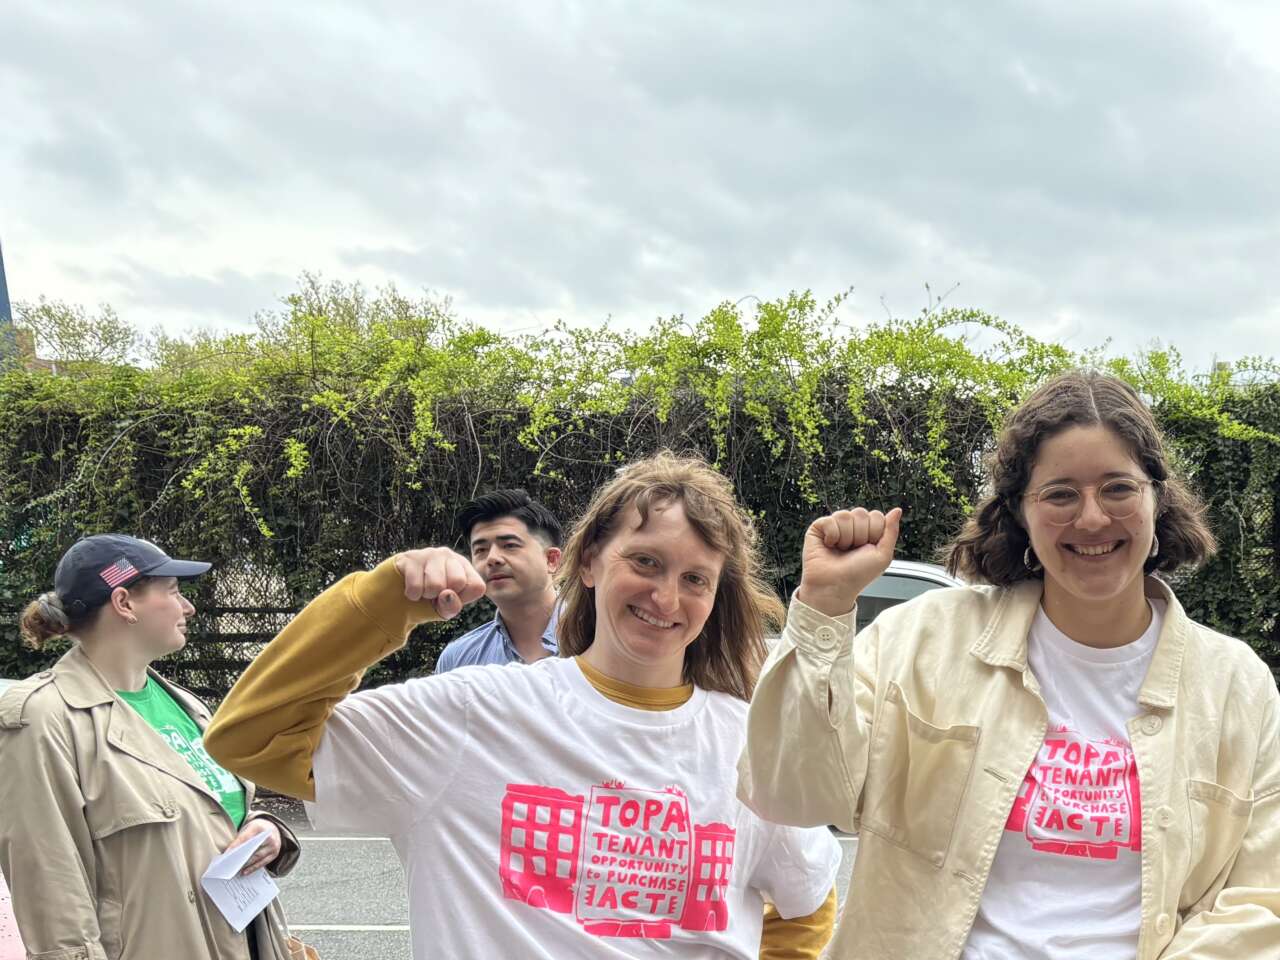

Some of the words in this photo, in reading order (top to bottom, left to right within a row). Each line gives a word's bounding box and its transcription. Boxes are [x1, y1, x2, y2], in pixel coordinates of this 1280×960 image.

[1045, 740, 1120, 768] TOPA
[1040, 766, 1123, 786] TENANT
[596, 796, 687, 832] TOPA
[592, 833, 688, 859] TENANT
[591, 855, 688, 875] OPPORTUNITY
[587, 869, 601, 880] to
[607, 870, 686, 892] PURCHASE
